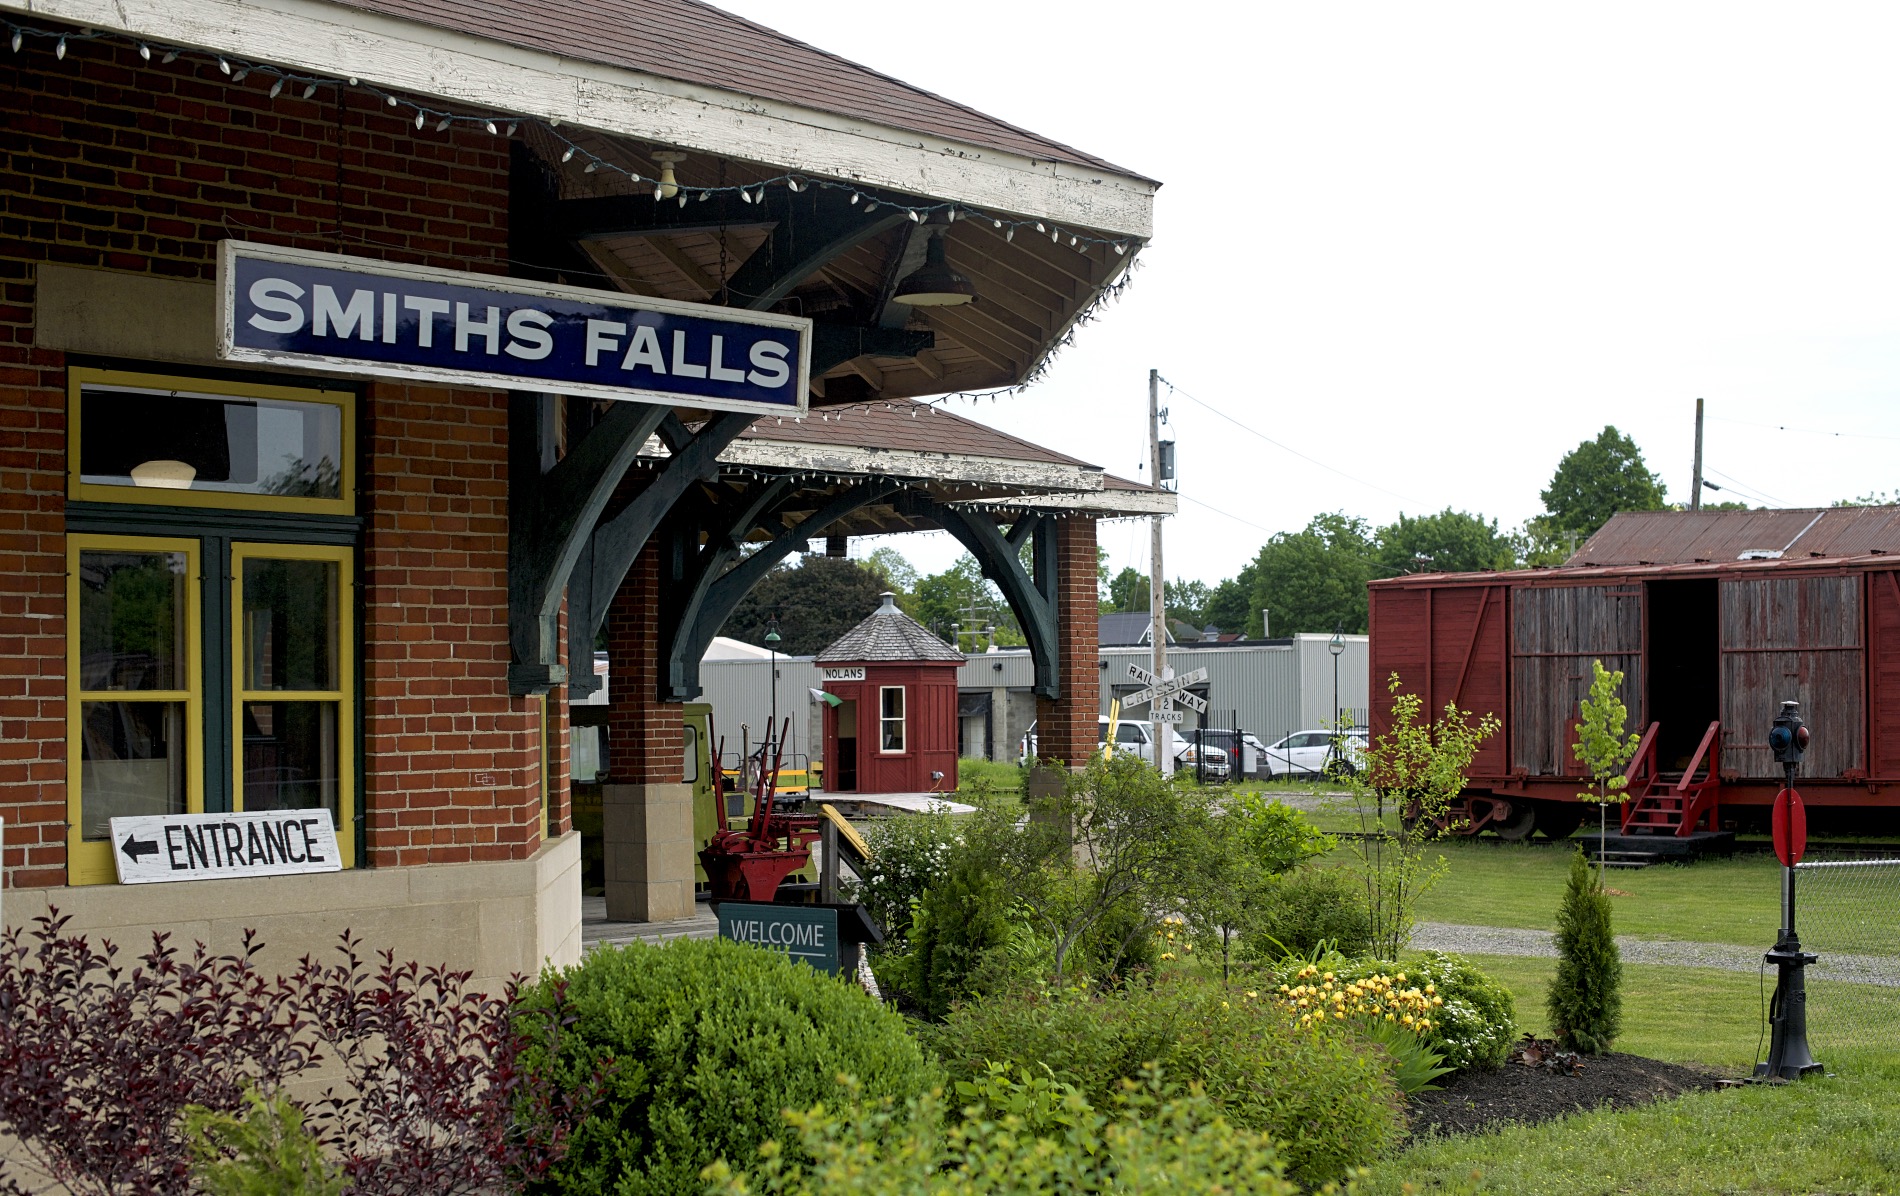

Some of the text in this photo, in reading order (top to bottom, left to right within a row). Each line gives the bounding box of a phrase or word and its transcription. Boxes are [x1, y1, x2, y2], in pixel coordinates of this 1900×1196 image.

[247, 278, 790, 389] SMITHS FALLS
[825, 668, 863, 679] NOLANS
[1126, 670, 1200, 707] CROSSING
[1128, 665, 1204, 711] RAIL WAY
[1150, 712, 1182, 721] TRACKS
[1163, 700, 1169, 710] 2
[164, 818, 325, 870] ENTRANCE
[730, 919, 825, 947] WELCOME
